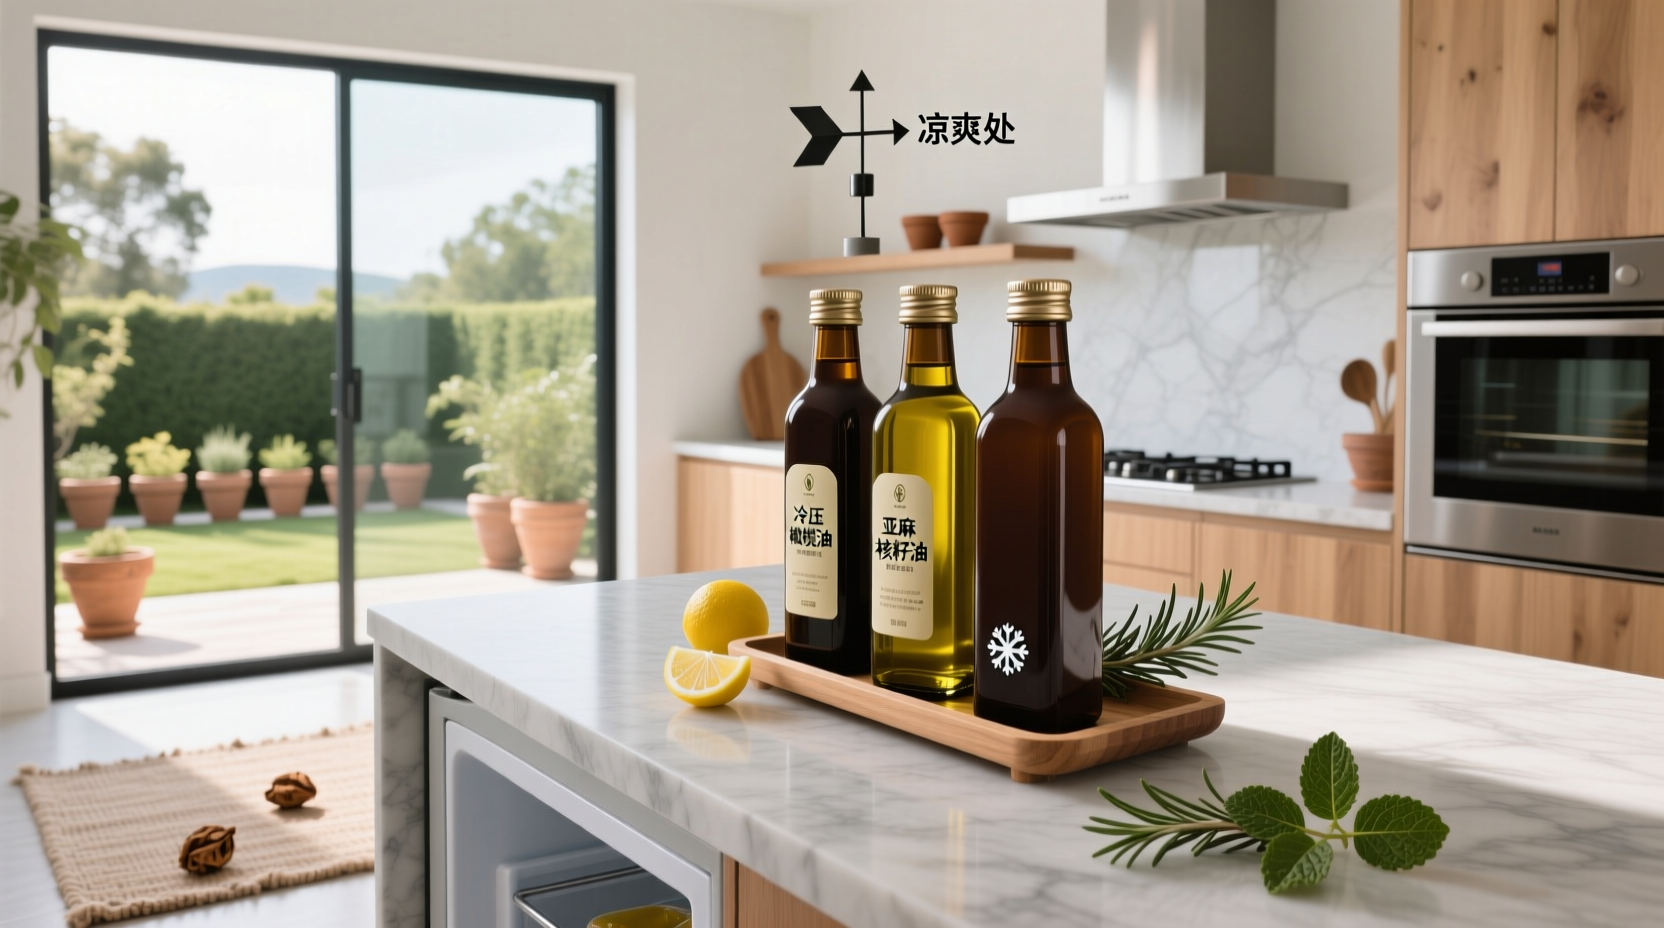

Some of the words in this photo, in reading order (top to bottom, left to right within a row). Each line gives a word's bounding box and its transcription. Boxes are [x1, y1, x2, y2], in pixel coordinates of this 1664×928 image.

[918, 111, 1015, 145] 凉爽处
[794, 504, 824, 525] 冷压
[881, 517, 916, 538] 亚麻
